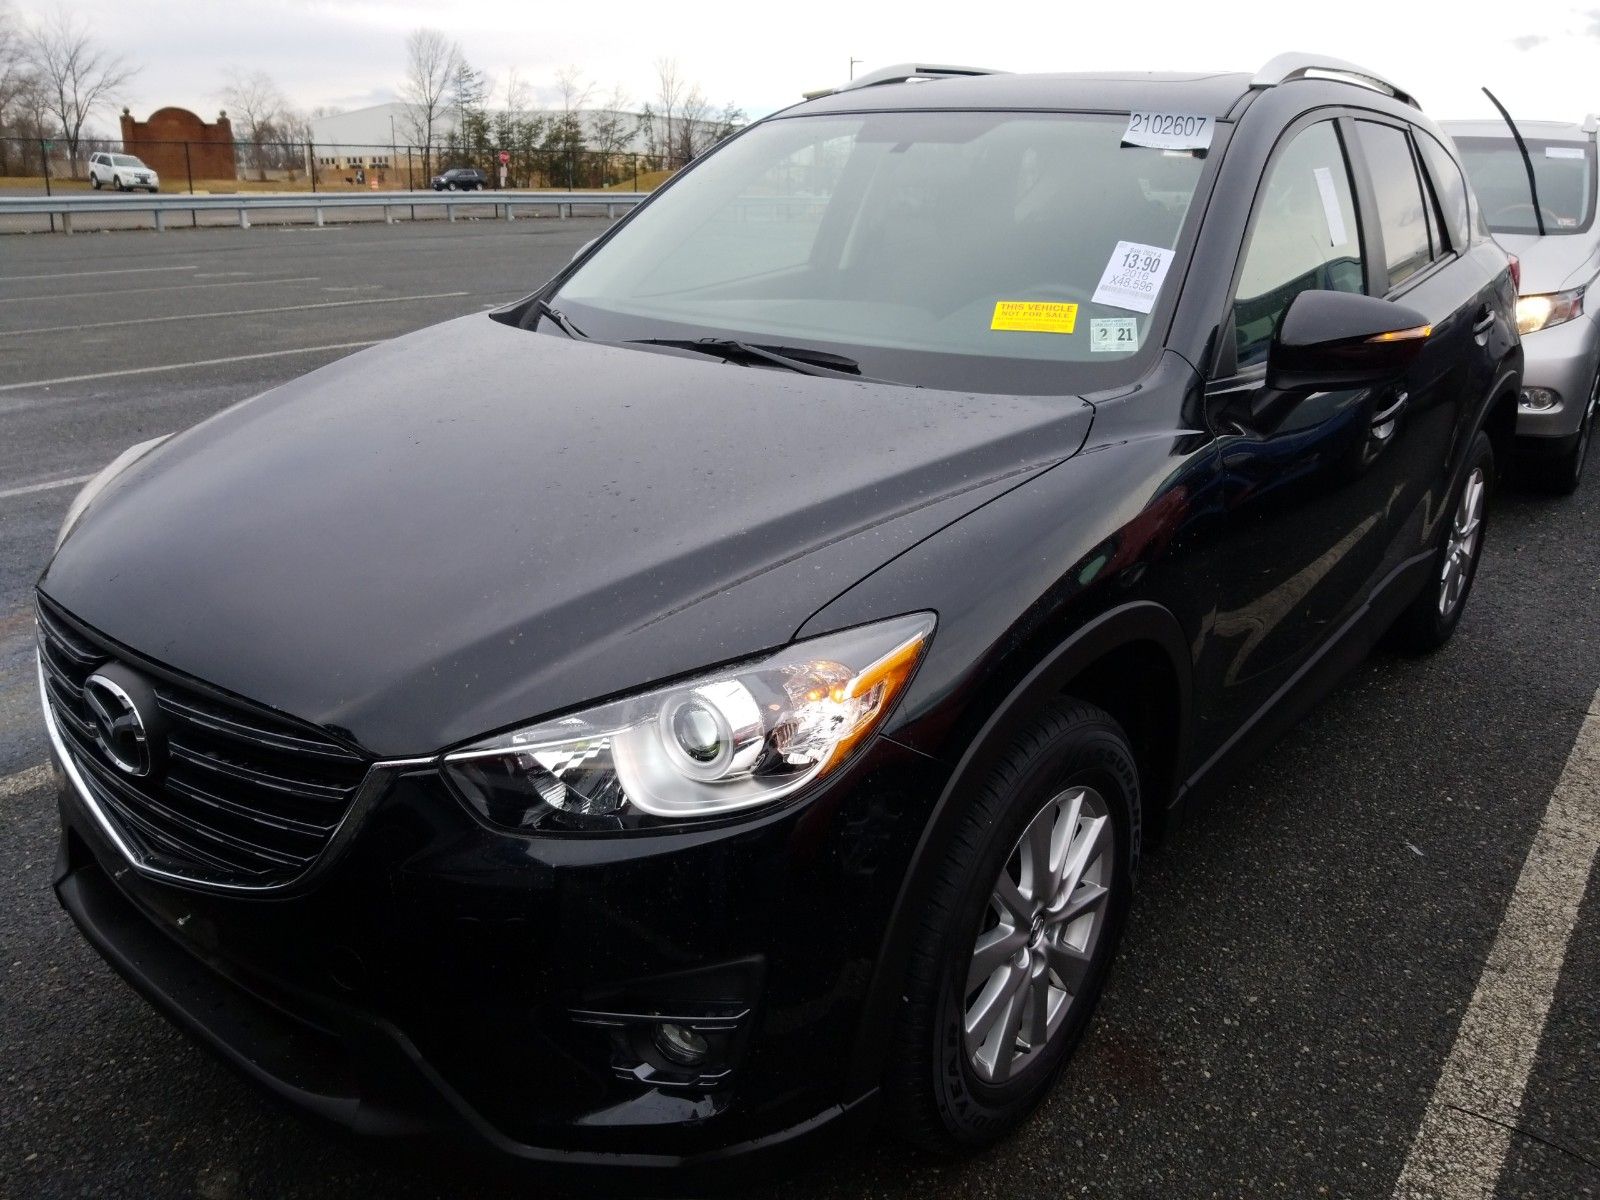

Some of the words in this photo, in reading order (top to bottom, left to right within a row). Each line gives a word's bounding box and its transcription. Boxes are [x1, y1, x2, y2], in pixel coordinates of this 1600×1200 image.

[1129, 113, 1207, 137] 2102607
[1121, 252, 1161, 274] 13:90
[1122, 269, 1150, 281] 2016
[1000, 303, 1025, 311] THIS
[1028, 303, 1075, 313] VEHICLE
[1045, 311, 1070, 319] SALE
[1117, 327, 1133, 341] 21
